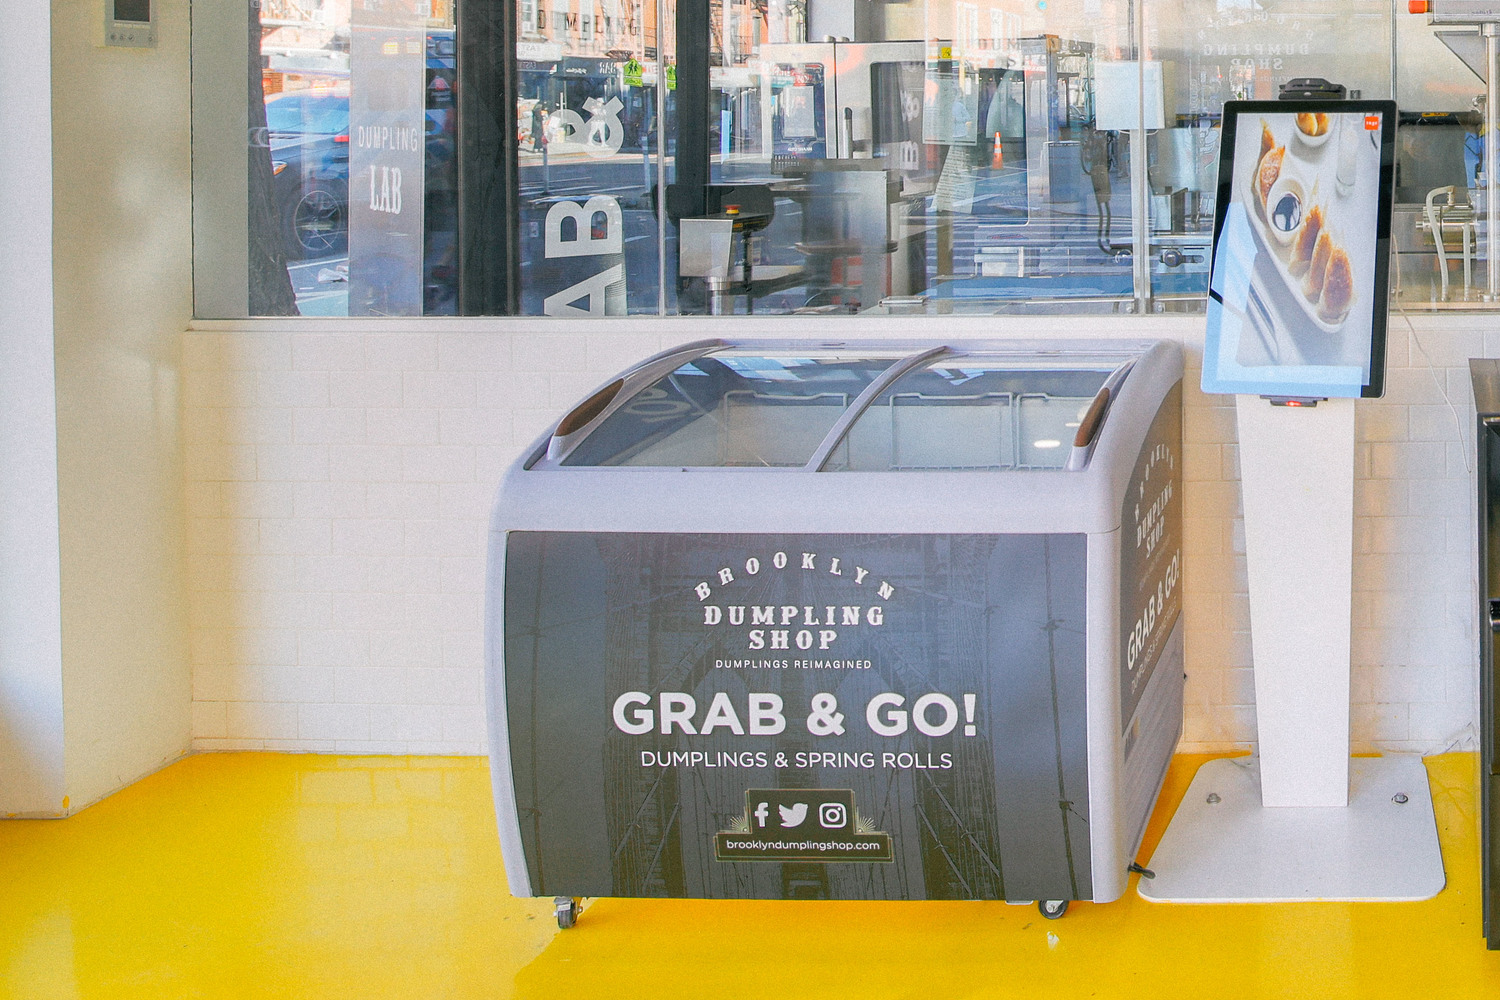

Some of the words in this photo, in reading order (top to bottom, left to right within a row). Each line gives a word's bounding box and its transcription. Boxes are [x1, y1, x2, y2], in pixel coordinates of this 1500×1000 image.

[359, 125, 417, 151] DUMPLING
[370, 165, 401, 215] LAB
[694, 551, 895, 601] BROOKLYN
[704, 606, 884, 626] DUMPLING
[1127, 594, 1155, 670] GRAB
[1165, 548, 1180, 599] GO!
[749, 630, 838, 650] SHOP
[715, 659, 788, 669] DUMPLINGS
[794, 660, 871, 669] REIMAGINED
[613, 691, 786, 735] GRAB
[807, 692, 846, 736] &
[866, 692, 977, 737] GO!
[641, 751, 768, 768] DUMPLINGS
[774, 752, 788, 767] &
[795, 752, 875, 769] SPRING
[883, 753, 953, 769] ROLLS
[726, 839, 880, 851] brooklyndumplingshop.com
